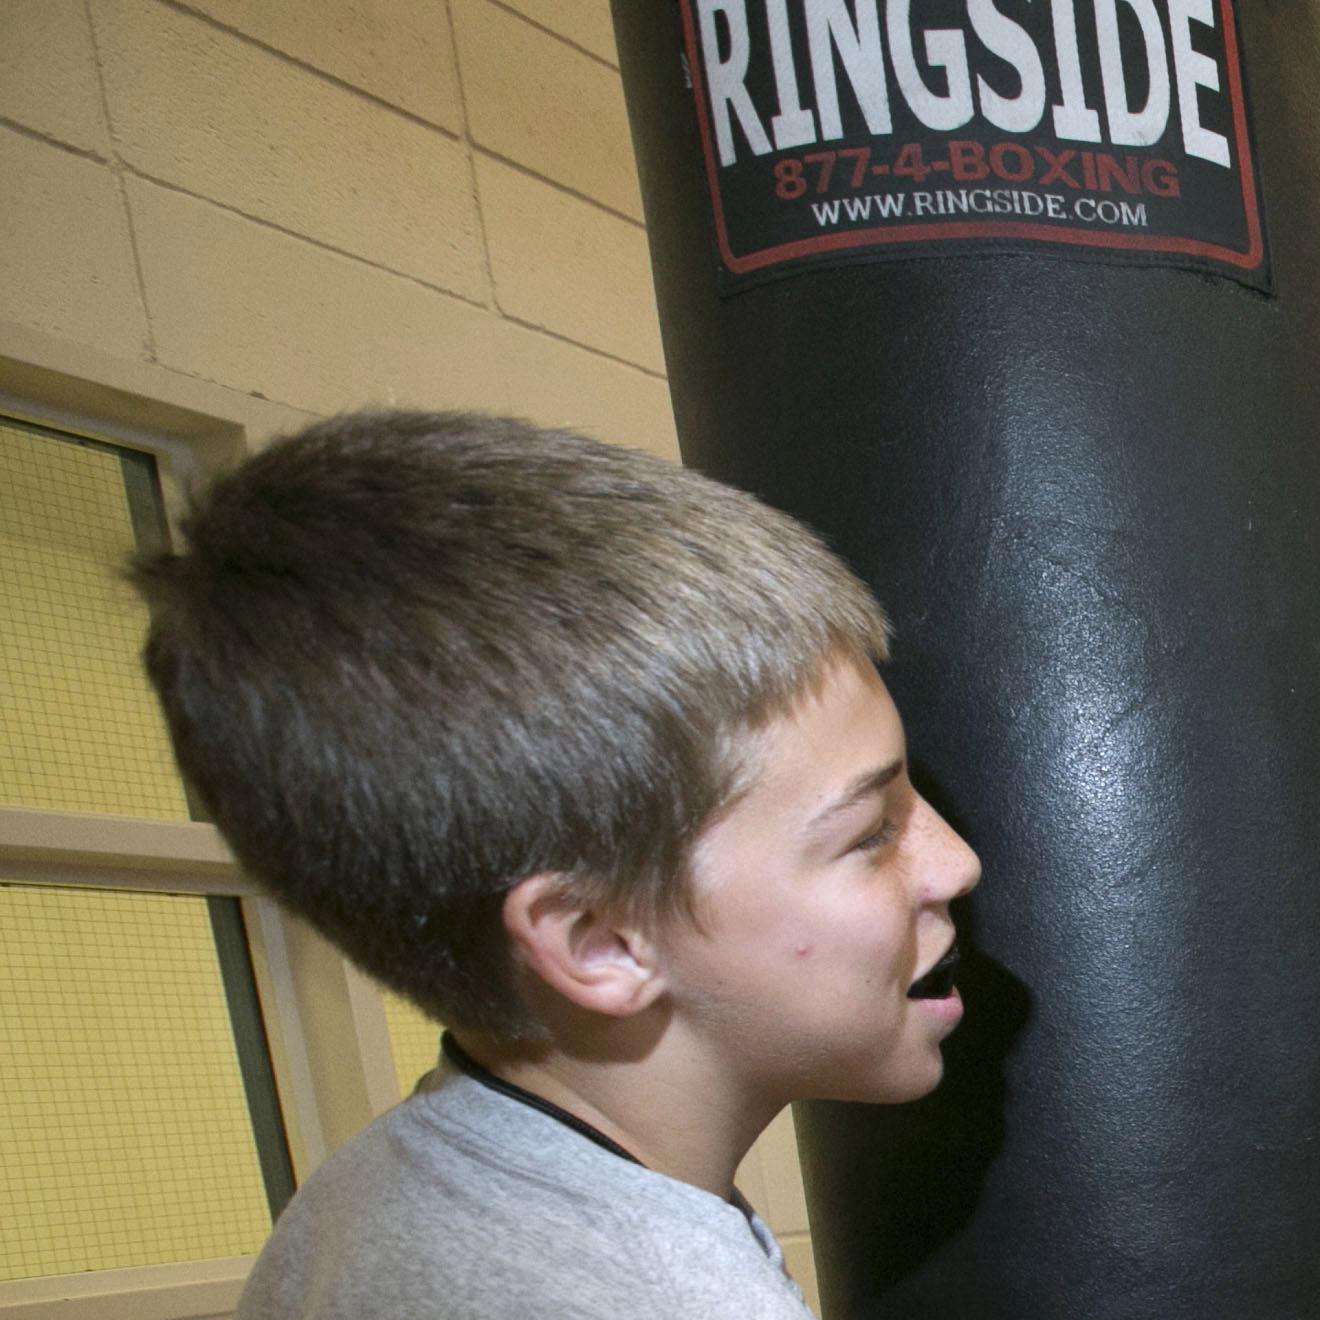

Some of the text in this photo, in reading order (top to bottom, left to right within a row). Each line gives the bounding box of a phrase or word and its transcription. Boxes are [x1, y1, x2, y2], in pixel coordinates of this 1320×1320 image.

[697, 0, 1231, 169] RINGSIDE
[773, 140, 1181, 200] 877-4-BOXING
[811, 189, 1149, 228] WWW.RINGSIDE.COM
